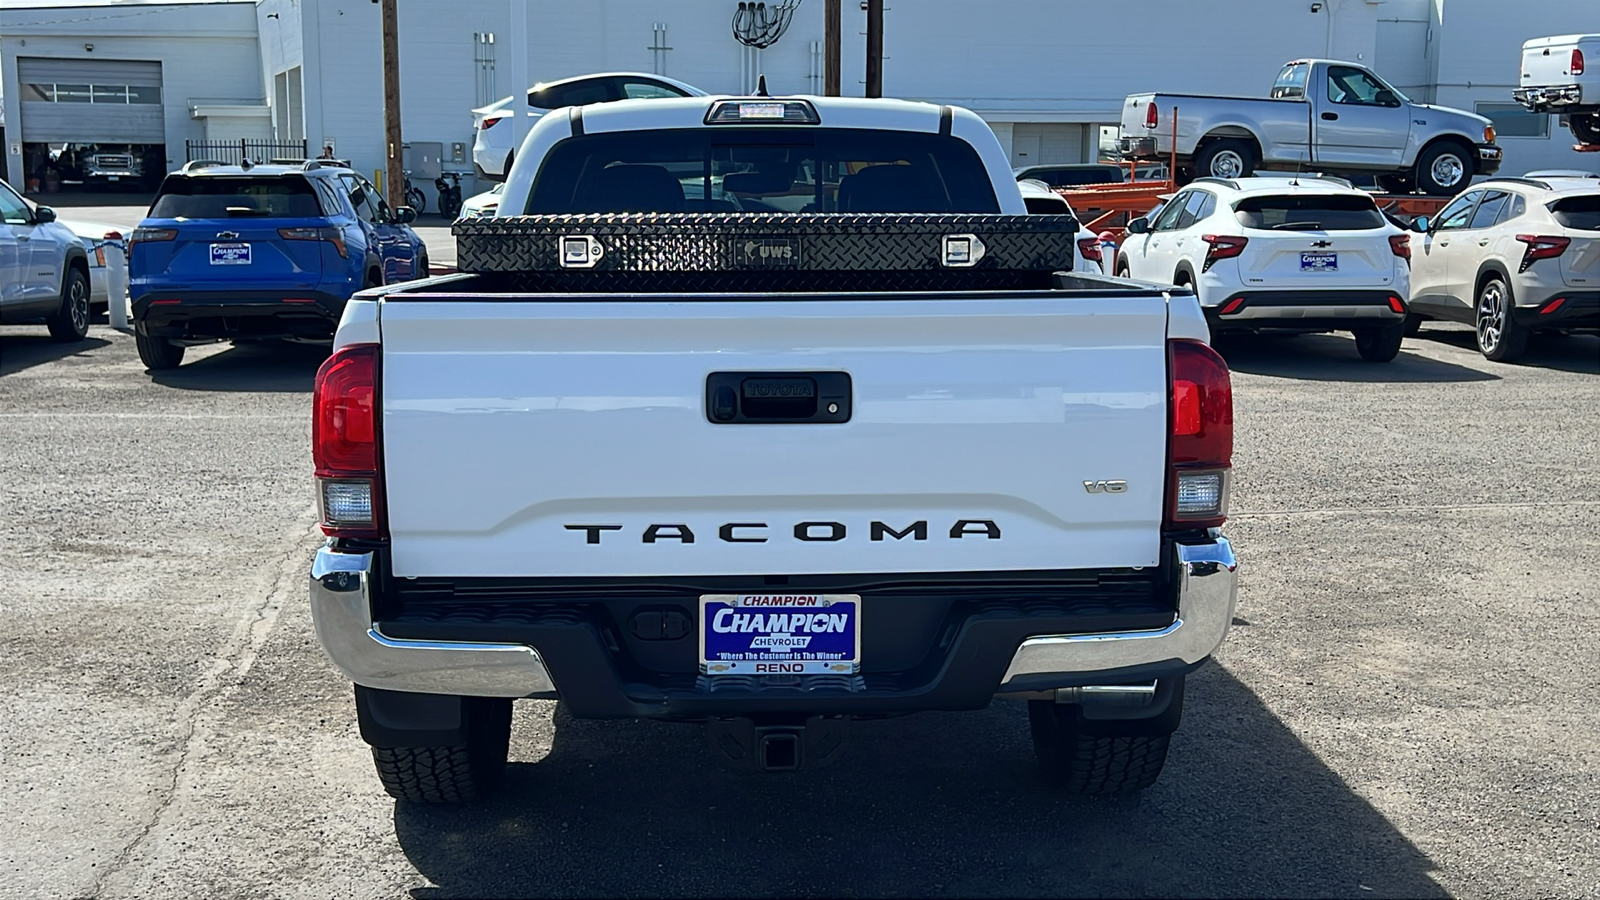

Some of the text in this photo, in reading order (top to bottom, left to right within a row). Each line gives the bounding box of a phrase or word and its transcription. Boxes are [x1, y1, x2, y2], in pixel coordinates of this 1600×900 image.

[213, 247, 248, 255] CHAMPION
[759, 246, 792, 258] UWS
[748, 383, 812, 396] TOYOTA
[1082, 479, 1128, 493] V6
[563, 519, 1002, 544] TACOMA
[743, 596, 817, 606] CHAMPION
[712, 608, 848, 633] CHAMPION
[754, 638, 807, 647] CHEVROLET
[745, 652, 758, 660] The
[759, 652, 793, 660] Customer
[794, 652, 801, 660] Is
[802, 652, 815, 660] The
[756, 663, 804, 673] RENO
